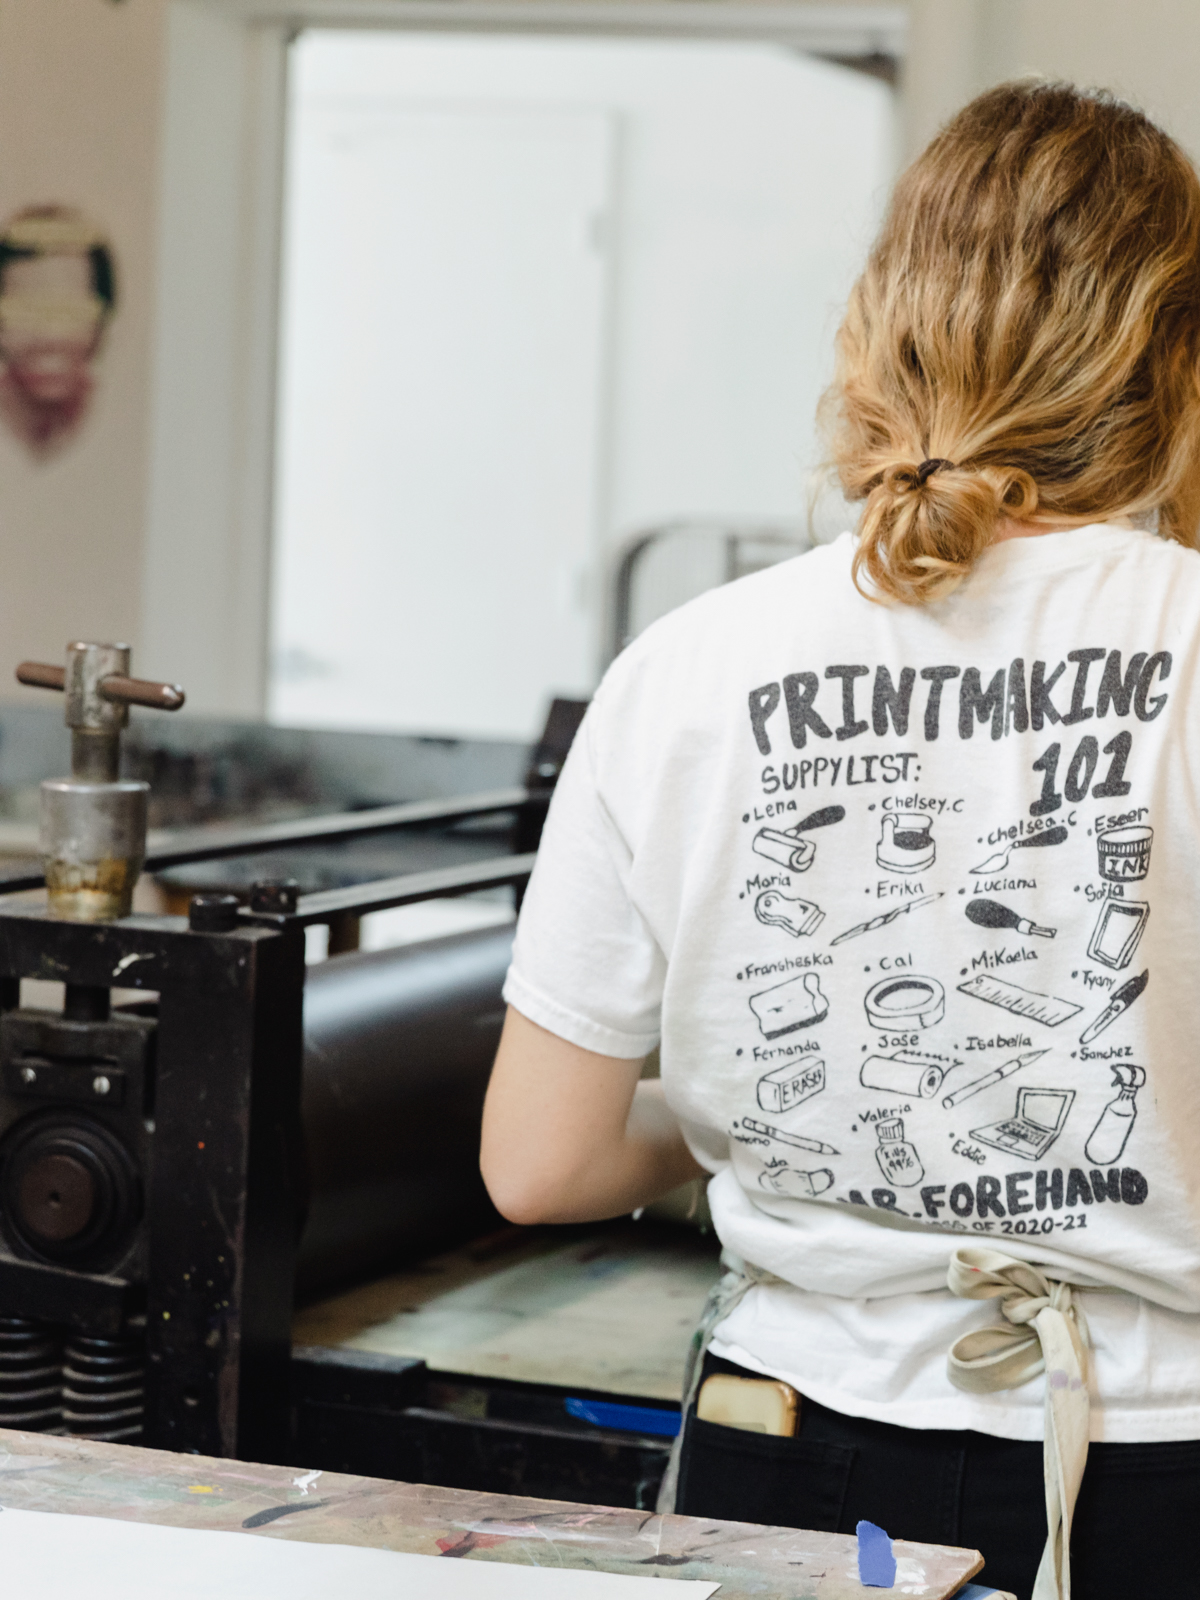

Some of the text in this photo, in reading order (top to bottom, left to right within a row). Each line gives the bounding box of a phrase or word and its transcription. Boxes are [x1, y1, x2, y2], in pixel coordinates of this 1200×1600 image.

[749, 647, 1173, 756] PRINTMAKING
[1029, 730, 1133, 817] 101
[754, 799, 797, 821] Lena
[1106, 854, 1149, 878] INK
[746, 872, 791, 895] Maria
[877, 879, 925, 899] Erika
[973, 878, 1037, 894] Luciana
[879, 953, 913, 971] Cal
[752, 1039, 821, 1062] Fernanda
[965, 1033, 1032, 1051] Isabella
[858, 1104, 912, 1123] Valeria
[920, 1166, 1149, 1219] FOREHAND
[1000, 1213, 1088, 1236] 2020-21
